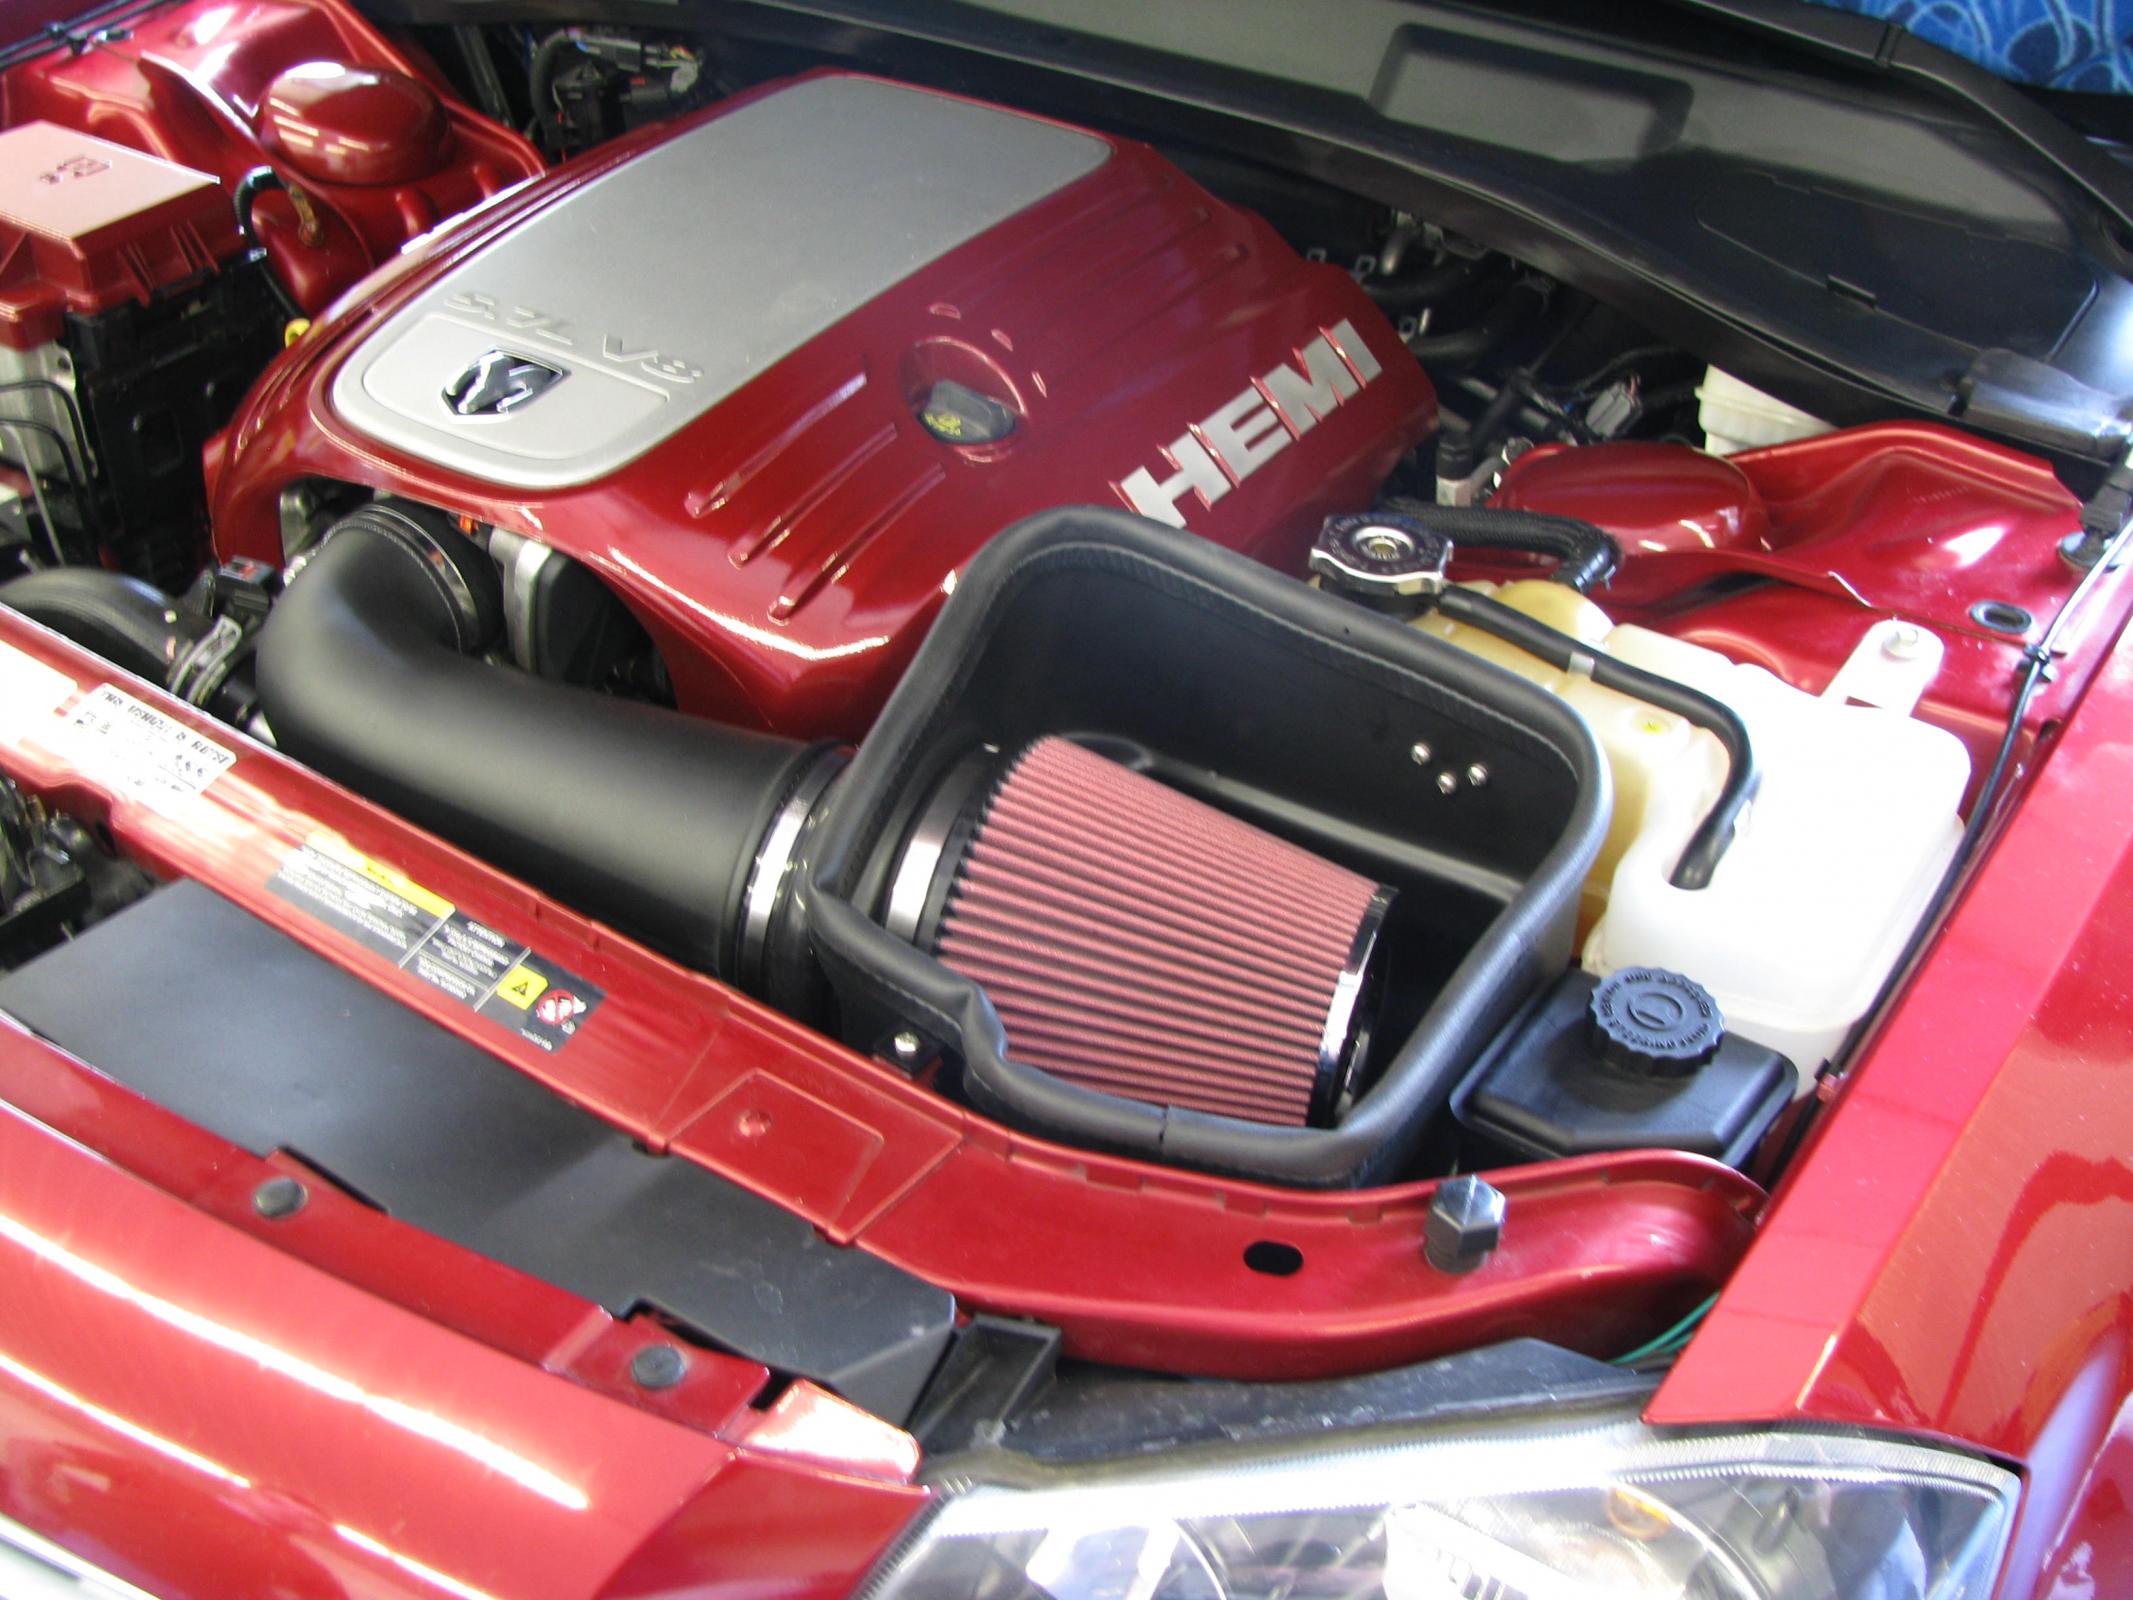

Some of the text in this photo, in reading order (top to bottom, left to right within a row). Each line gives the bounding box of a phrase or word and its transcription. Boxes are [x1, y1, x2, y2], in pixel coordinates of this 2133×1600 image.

[443, 291, 704, 385] 5.7L V8
[1108, 317, 1383, 529] HEMI
